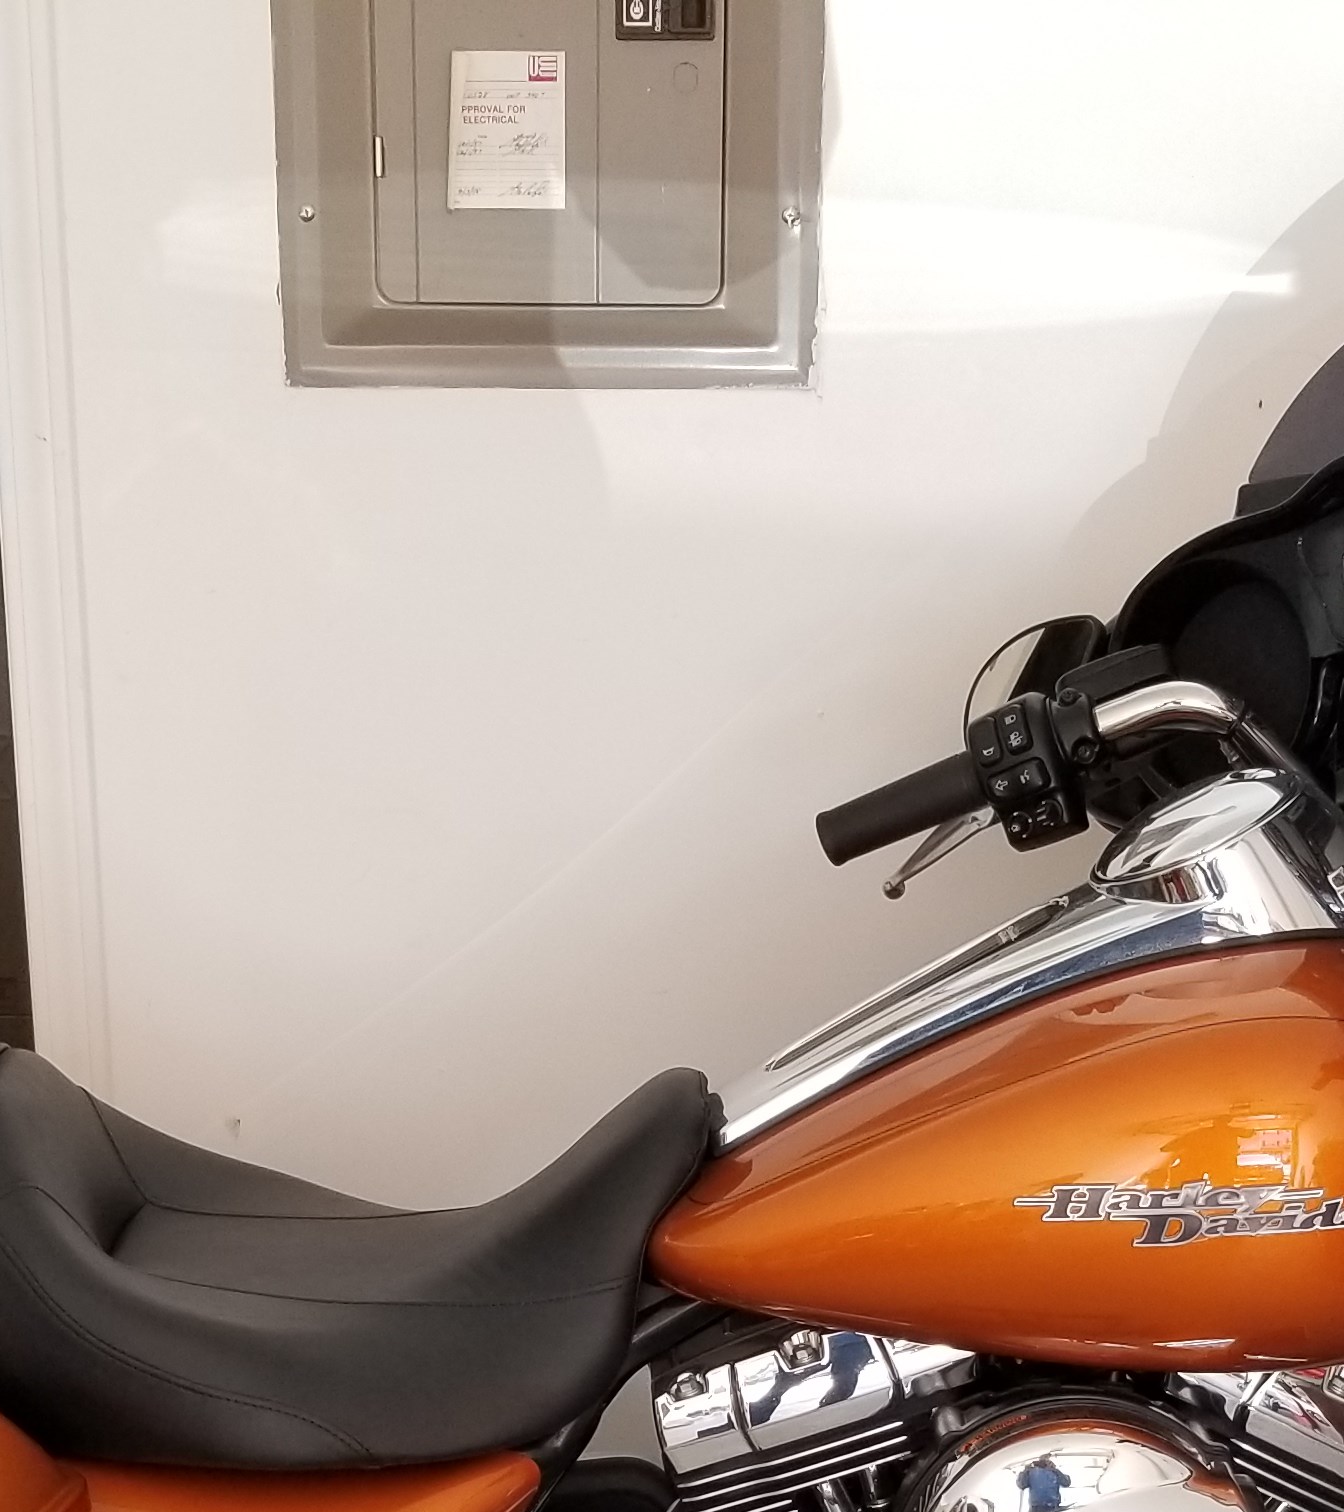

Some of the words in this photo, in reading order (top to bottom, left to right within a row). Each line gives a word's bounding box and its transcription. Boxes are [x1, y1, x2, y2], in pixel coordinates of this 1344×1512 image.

[508, 105, 525, 114] FOR
[463, 115, 520, 124] ELECTRICAL
[1016, 1181, 1323, 1224] Harley
